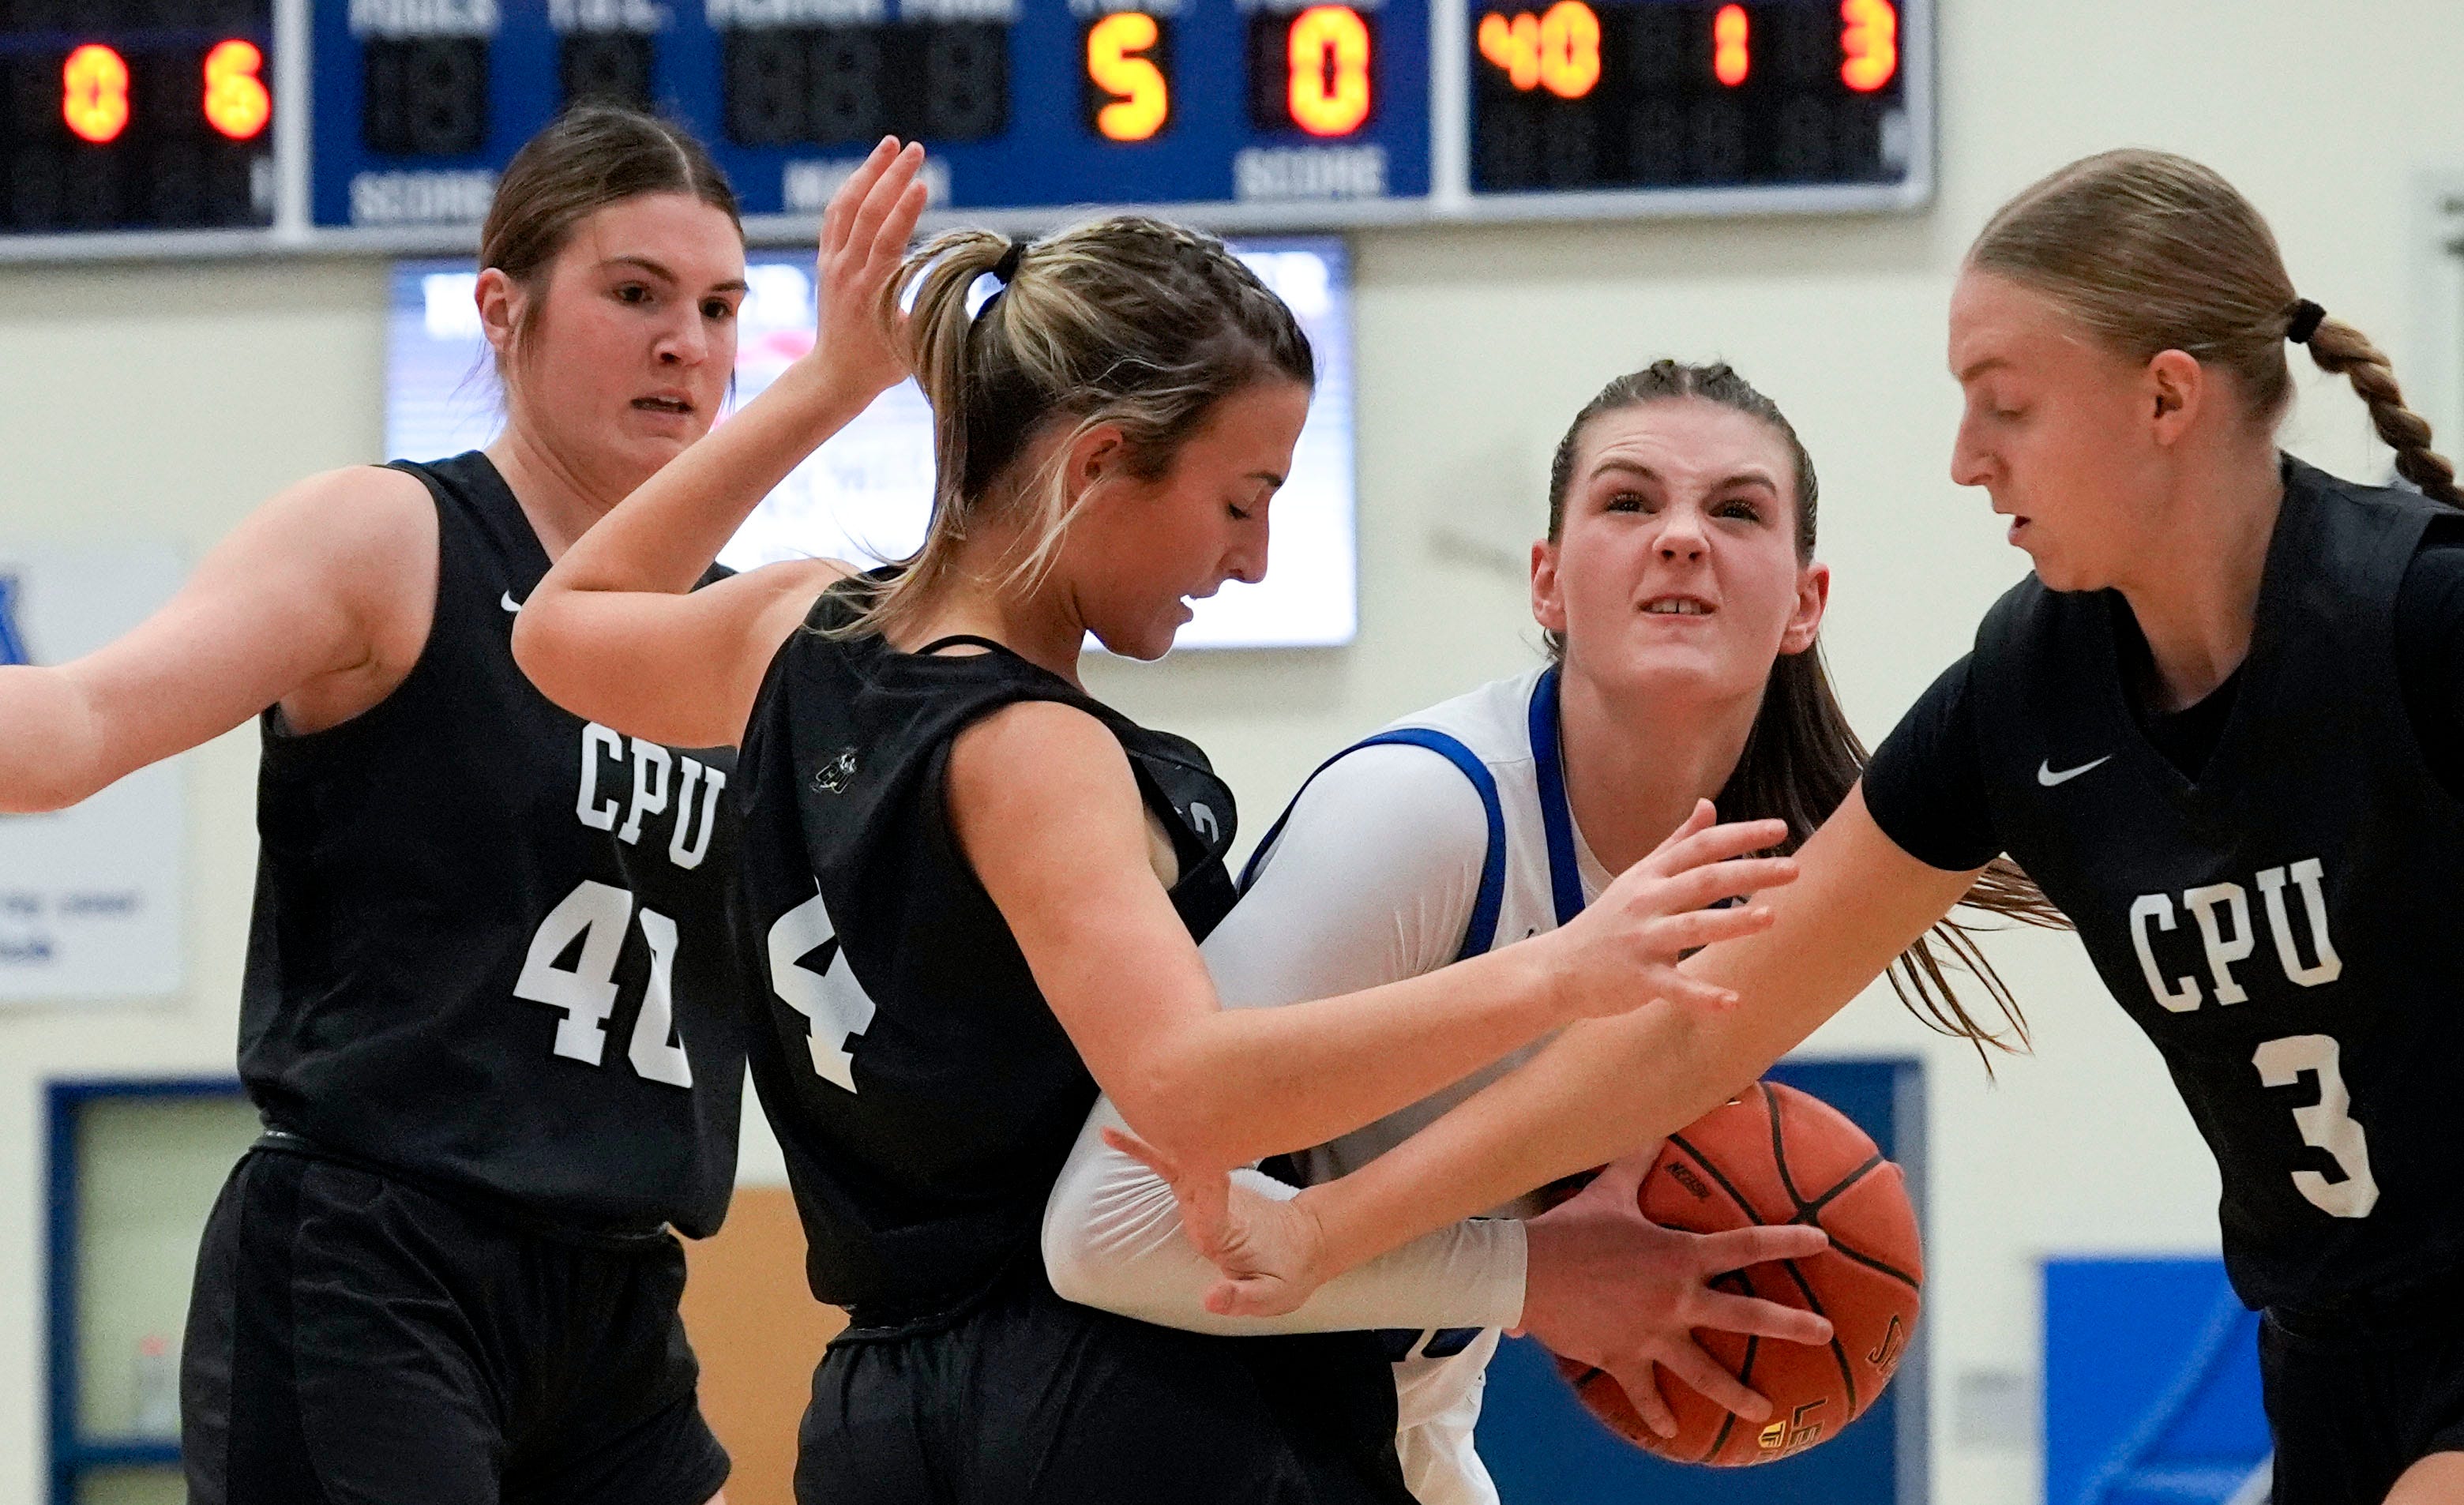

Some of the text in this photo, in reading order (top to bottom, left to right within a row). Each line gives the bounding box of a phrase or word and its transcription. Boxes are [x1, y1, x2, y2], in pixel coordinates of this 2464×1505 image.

[62, 39, 271, 142] 0 6
[1087, 12, 1167, 141] 5
[1287, 4, 1370, 137] 0
[1478, 0, 1896, 98] 40 1 3
[576, 721, 726, 870] CPU
[768, 874, 877, 1094] 4
[2130, 858, 2342, 1013] CPU
[2252, 1034, 2380, 1218] 3
